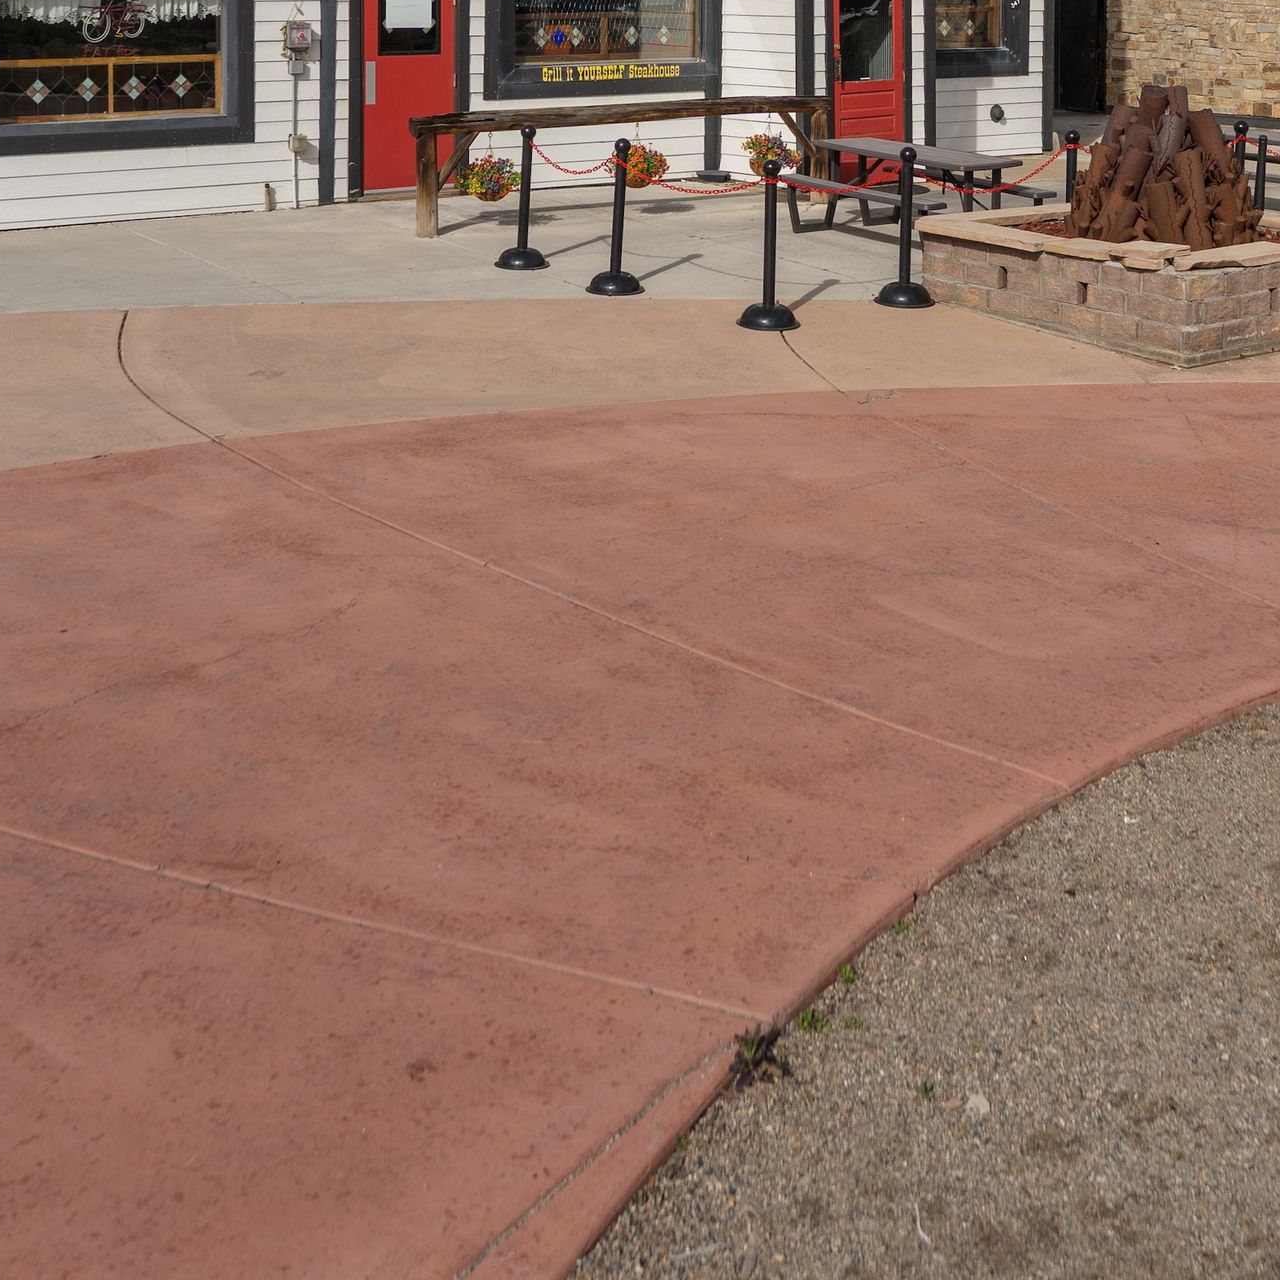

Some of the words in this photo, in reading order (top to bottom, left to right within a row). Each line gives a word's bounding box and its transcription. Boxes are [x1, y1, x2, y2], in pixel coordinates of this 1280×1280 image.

[542, 66, 562, 82] Grill
[566, 67, 573, 81] it
[577, 65, 625, 81] YOURSELF
[628, 64, 680, 79] Steakhouse
